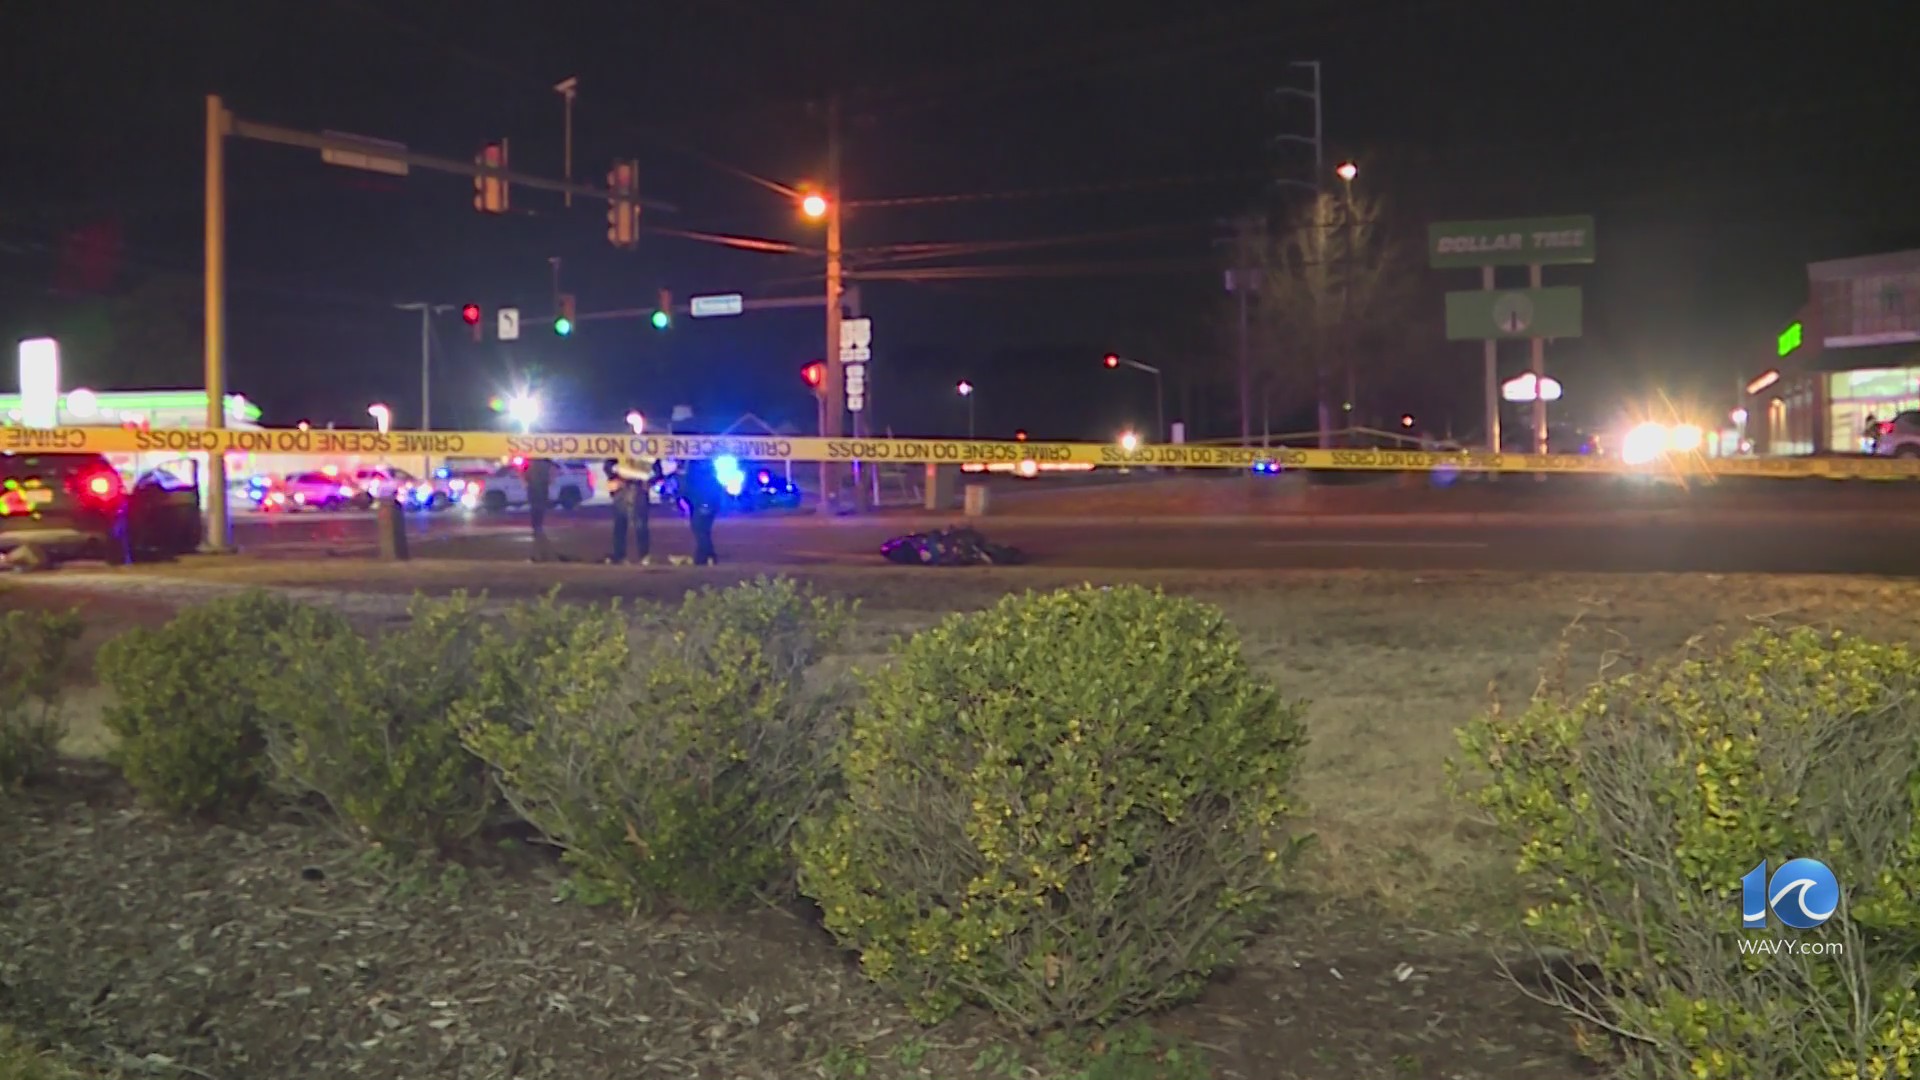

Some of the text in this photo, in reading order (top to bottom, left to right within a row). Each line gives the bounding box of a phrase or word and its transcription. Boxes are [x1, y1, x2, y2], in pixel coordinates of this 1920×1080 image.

[1437, 229, 1586, 253] DOLLAR TREE
[7, 428, 86, 449] CRIME
[136, 430, 465, 452] CRIME SCENE DO NOT CROSS
[506, 435, 579, 454] CROSS
[585, 436, 625, 455] NOT
[629, 436, 658, 456] DO
[828, 439, 890, 458] CROSS
[895, 440, 930, 458] NOT
[933, 441, 959, 459] DO
[962, 443, 1018, 460] SCENE
[1102, 446, 1154, 463] CROSS
[1159, 447, 1188, 463] NOT
[1191, 448, 1212, 463] DO
